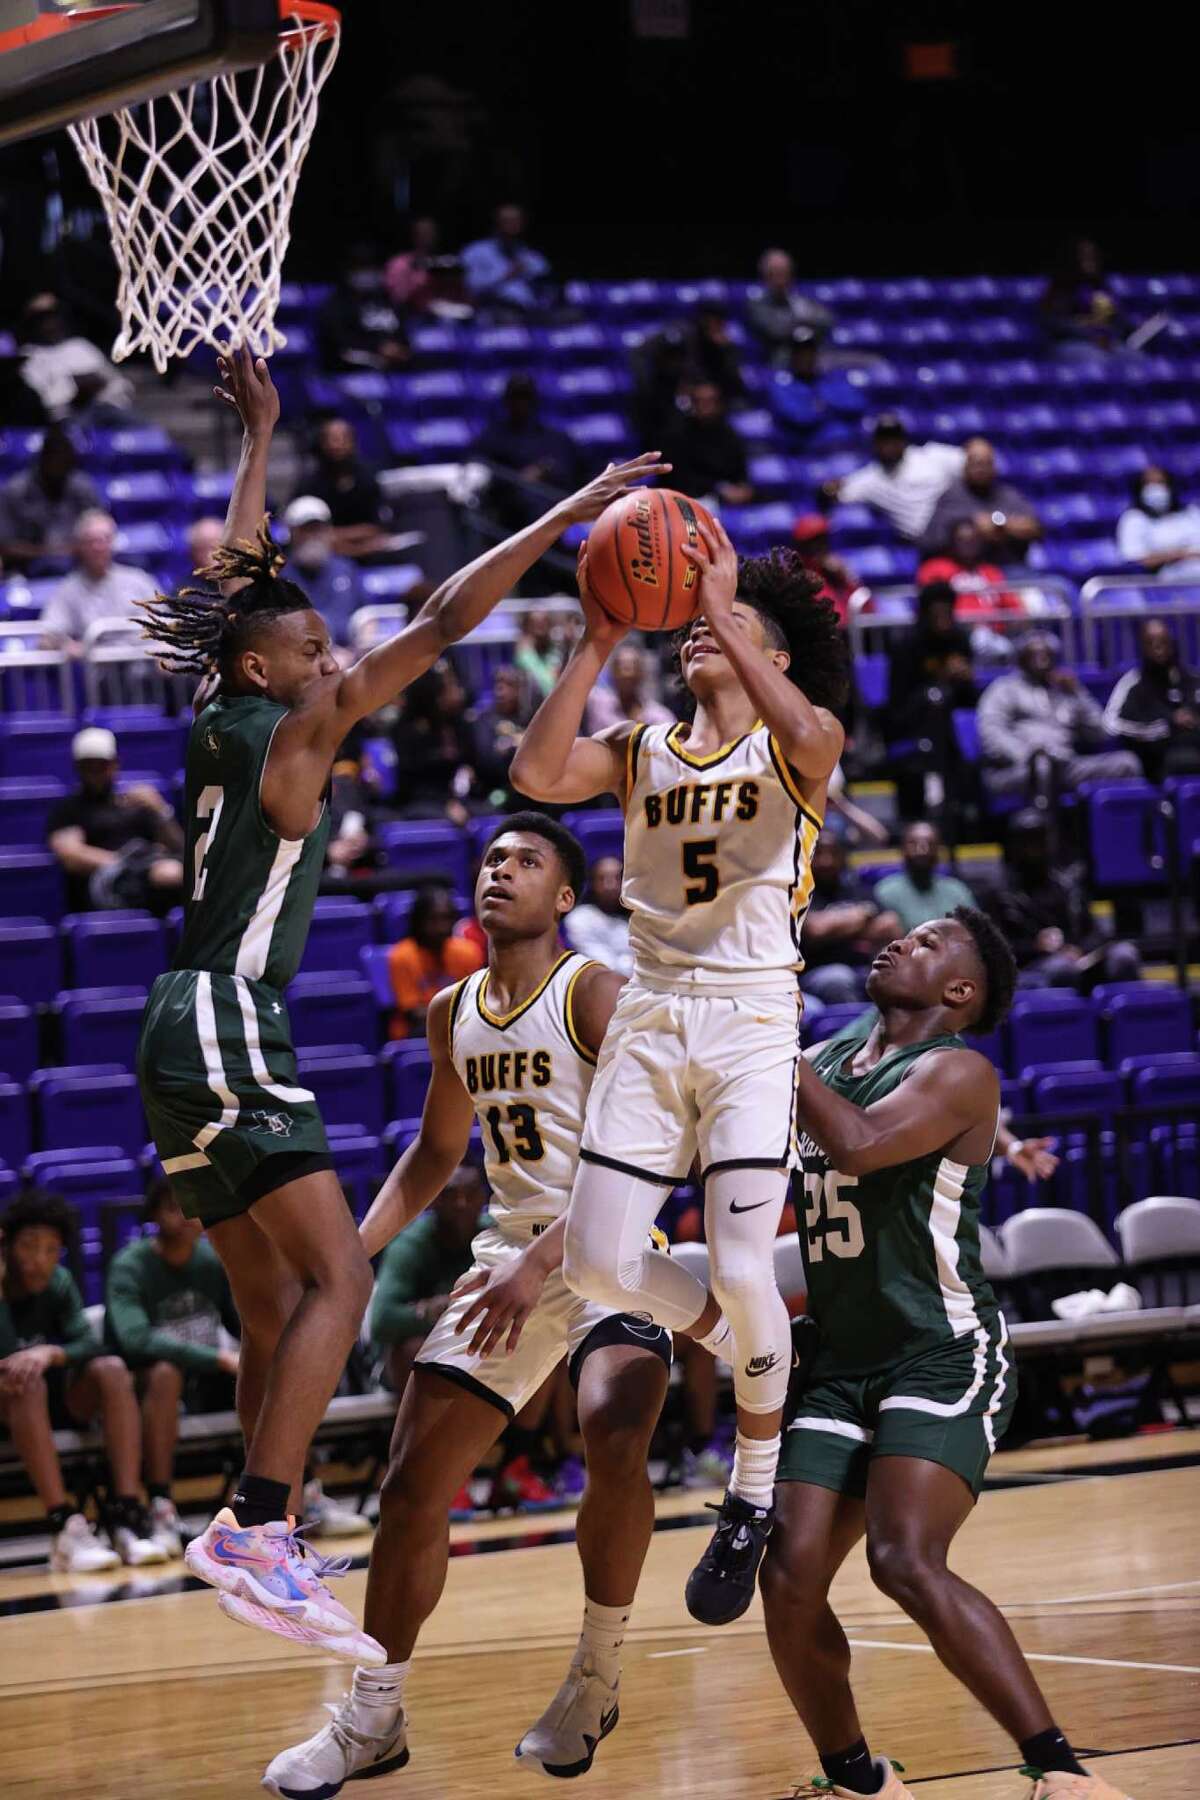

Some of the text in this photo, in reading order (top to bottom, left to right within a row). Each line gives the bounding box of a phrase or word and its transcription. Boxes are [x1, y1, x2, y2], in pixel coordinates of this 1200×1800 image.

[627, 499, 659, 587] Baden
[643, 780, 760, 829] BUFFS
[192, 785, 225, 901] 2
[682, 838, 720, 906] 5
[465, 1050, 552, 1094] BUFFS
[485, 1102, 546, 1164] 13
[803, 1169, 866, 1264] 25
[749, 1352, 776, 1370] NIKE
